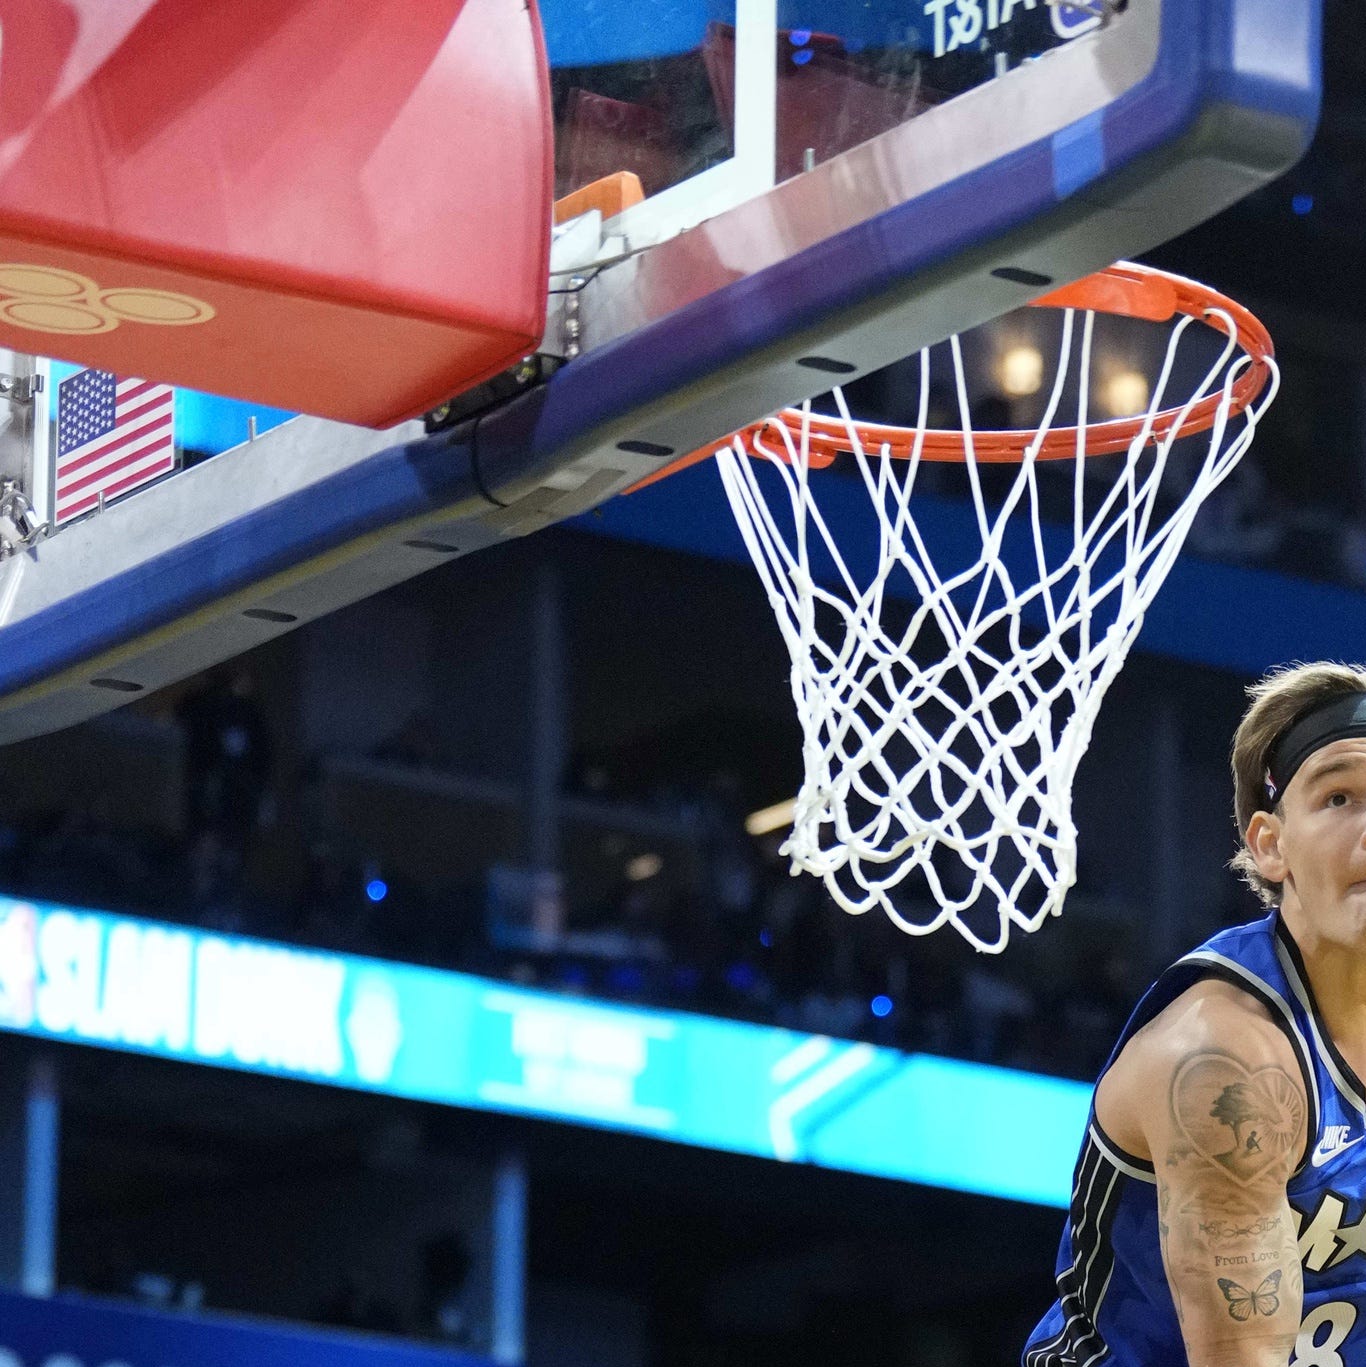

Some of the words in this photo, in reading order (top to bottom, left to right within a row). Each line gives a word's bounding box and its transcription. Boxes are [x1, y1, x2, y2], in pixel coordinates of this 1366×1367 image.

[1319, 1126, 1351, 1150] NIKE
[1214, 1254, 1248, 1267] From
[1251, 1250, 1280, 1263] Love
